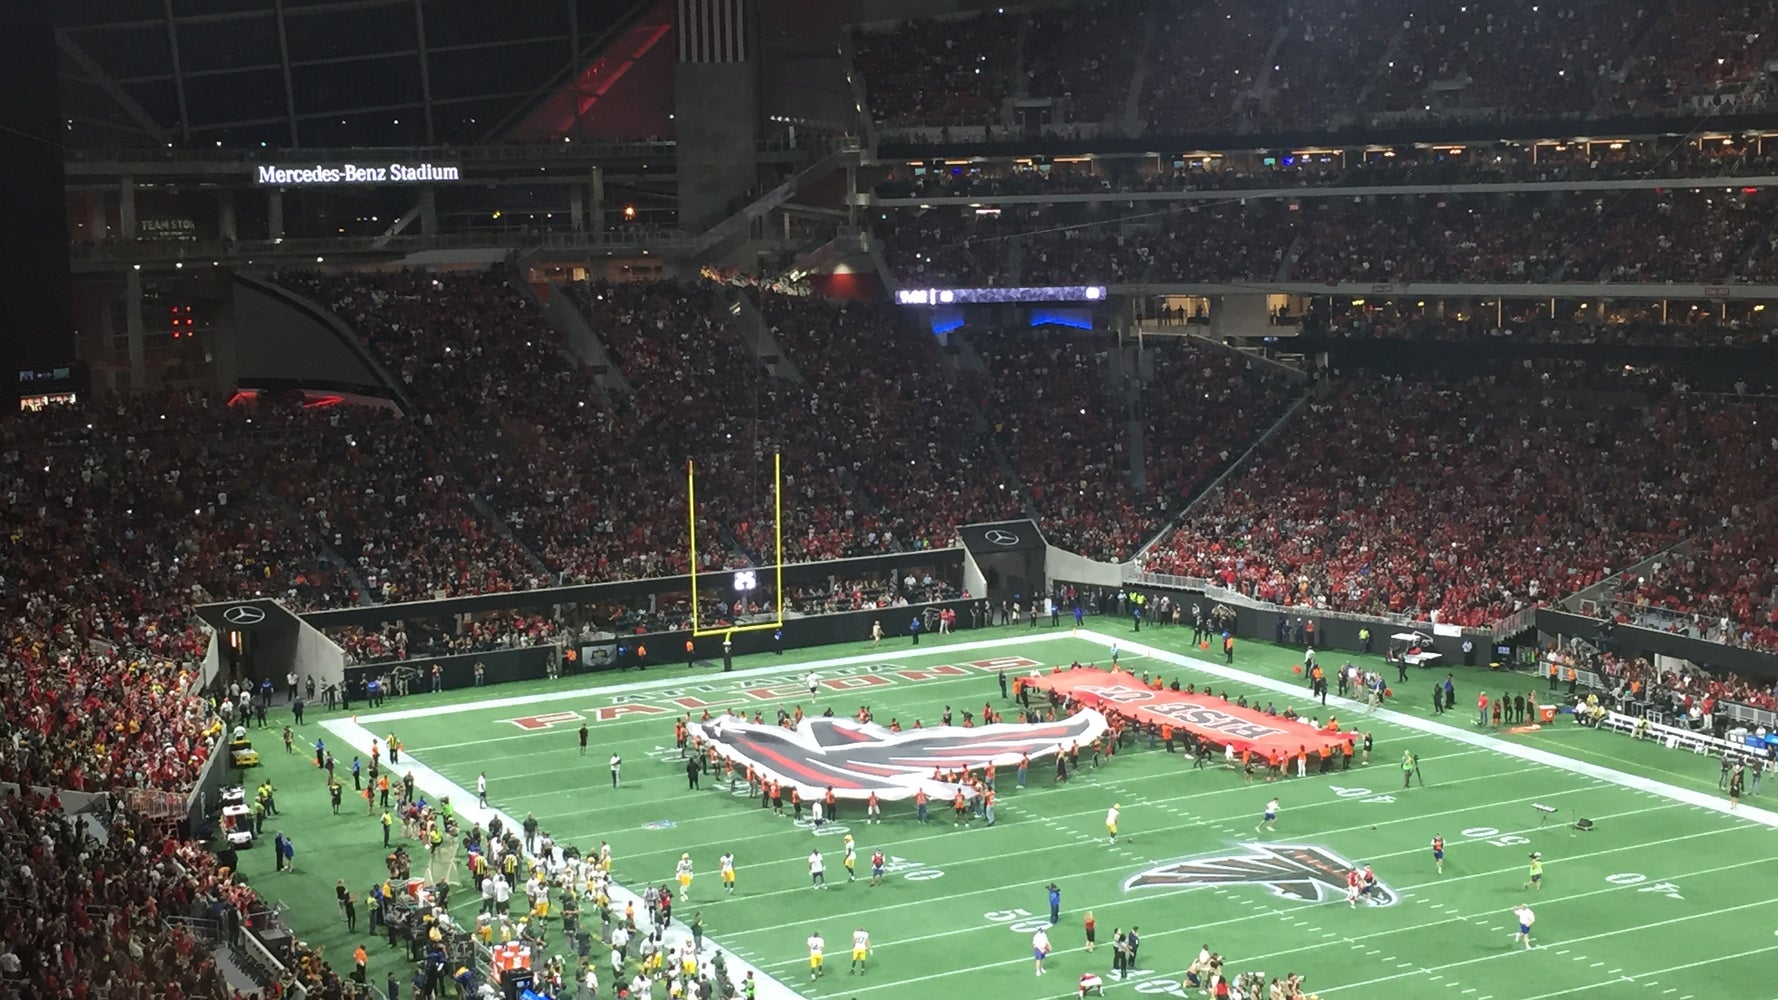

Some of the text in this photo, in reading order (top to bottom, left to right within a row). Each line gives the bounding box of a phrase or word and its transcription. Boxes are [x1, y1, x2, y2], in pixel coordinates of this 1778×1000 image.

[258, 163, 459, 183] Mercedes-Benz Stadium
[140, 219, 169, 231] TEAM
[493, 656, 1044, 731] FALCONS
[612, 662, 907, 704] ATLANTA
[1140, 702, 1288, 740] RISE
